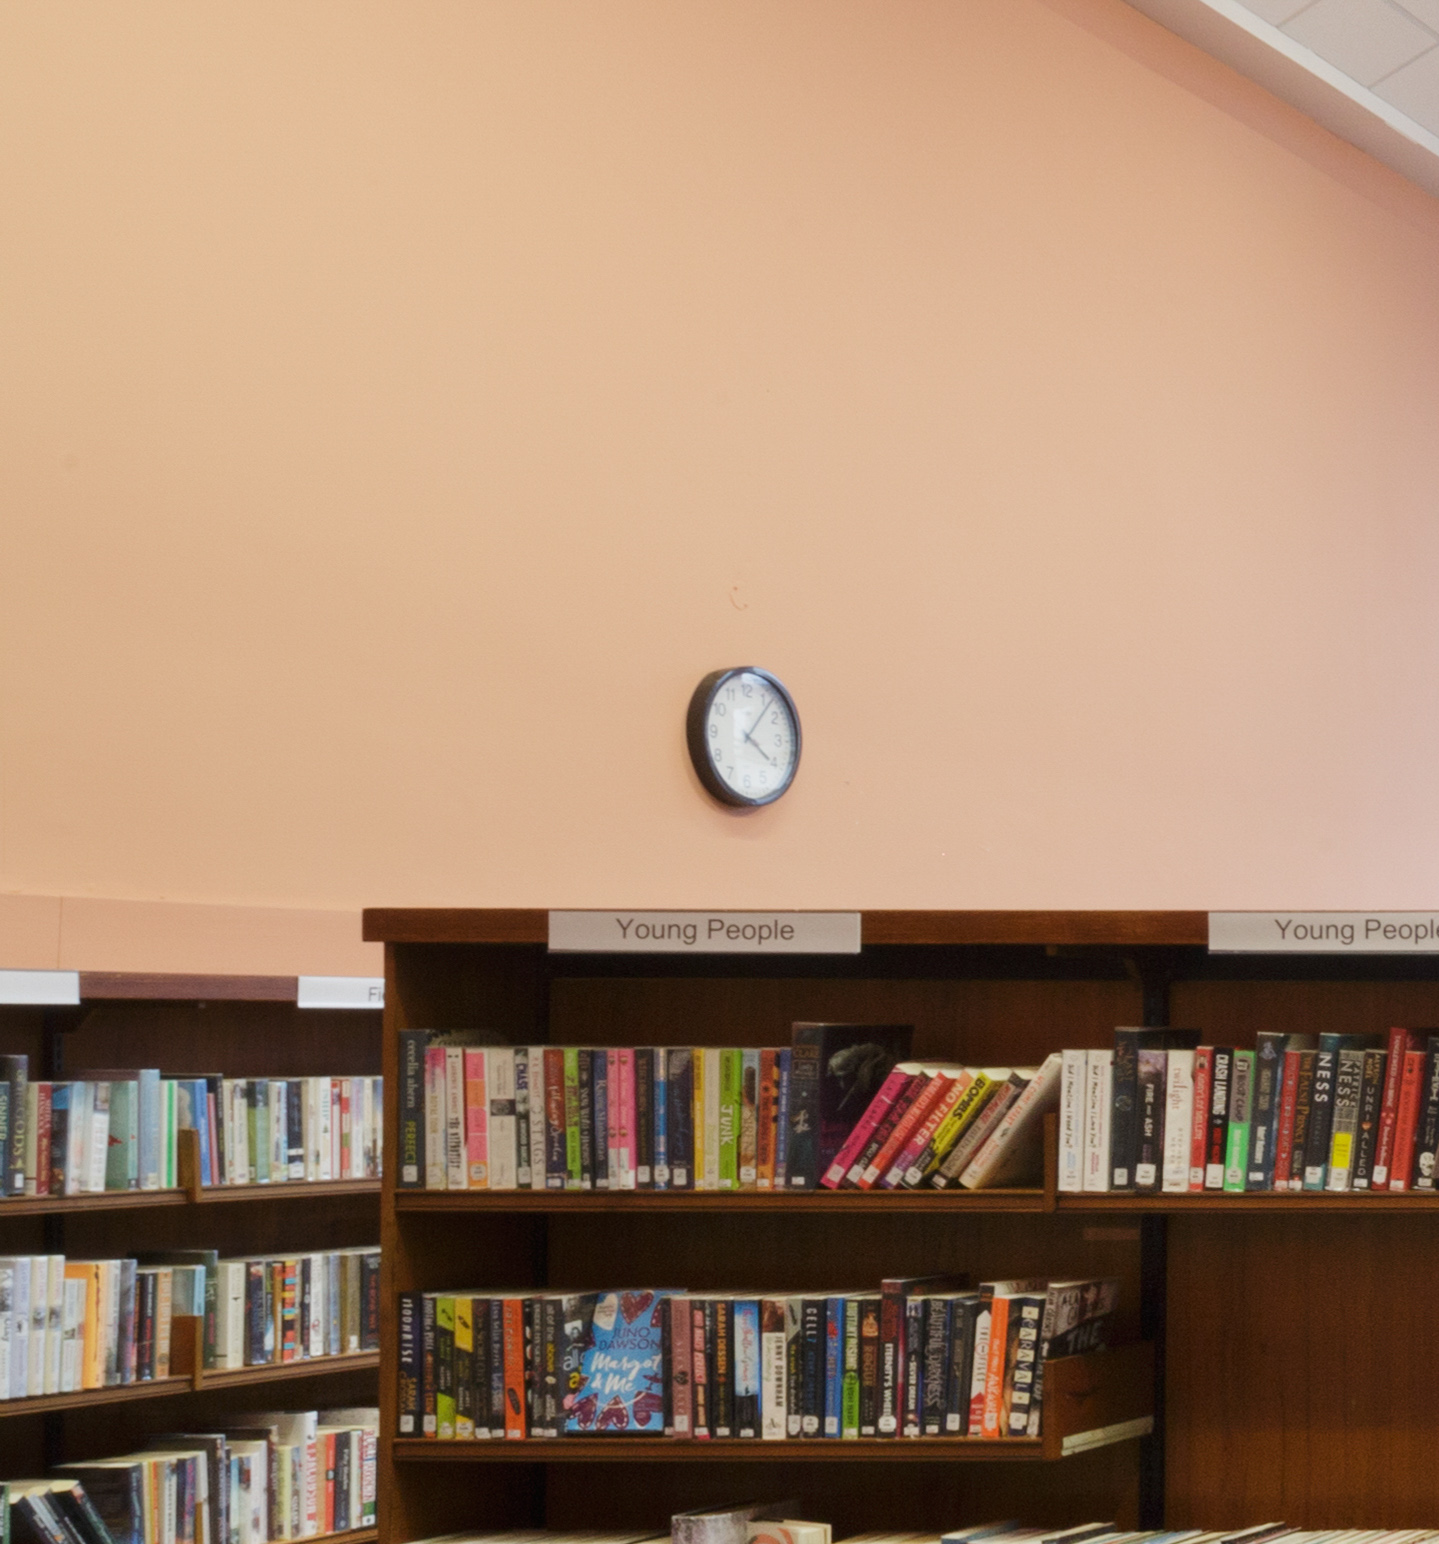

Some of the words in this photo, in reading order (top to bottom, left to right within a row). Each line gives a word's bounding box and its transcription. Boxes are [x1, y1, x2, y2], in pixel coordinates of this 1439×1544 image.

[615, 918, 698, 946] Young
[707, 918, 795, 946] People
[1274, 918, 1355, 946] Young
[405, 1039, 420, 1077] cecelia
[1215, 1054, 1229, 1081] CRASH
[405, 1077, 419, 1109] ahern
[1314, 1054, 1333, 1104] NESS
[1336, 1059, 1355, 1108] NESS
[1349, 1060, 1363, 1109] PATRICK
[1212, 1081, 1227, 1116] LANDING
[719, 1103, 734, 1146] JUNK
[400, 1298, 415, 1364] MOONRISE
[613, 1325, 652, 1339] JUNO
[716, 1303, 726, 1338] SARAH
[598, 1337, 662, 1352] DAWSON
[716, 1337, 727, 1375] DESSEN
[774, 1335, 785, 1362] JENNY
[590, 1351, 664, 1382] Margot
[590, 1372, 604, 1390] &
[604, 1372, 636, 1396] Me
[774, 1364, 785, 1409] DOWNHAM
